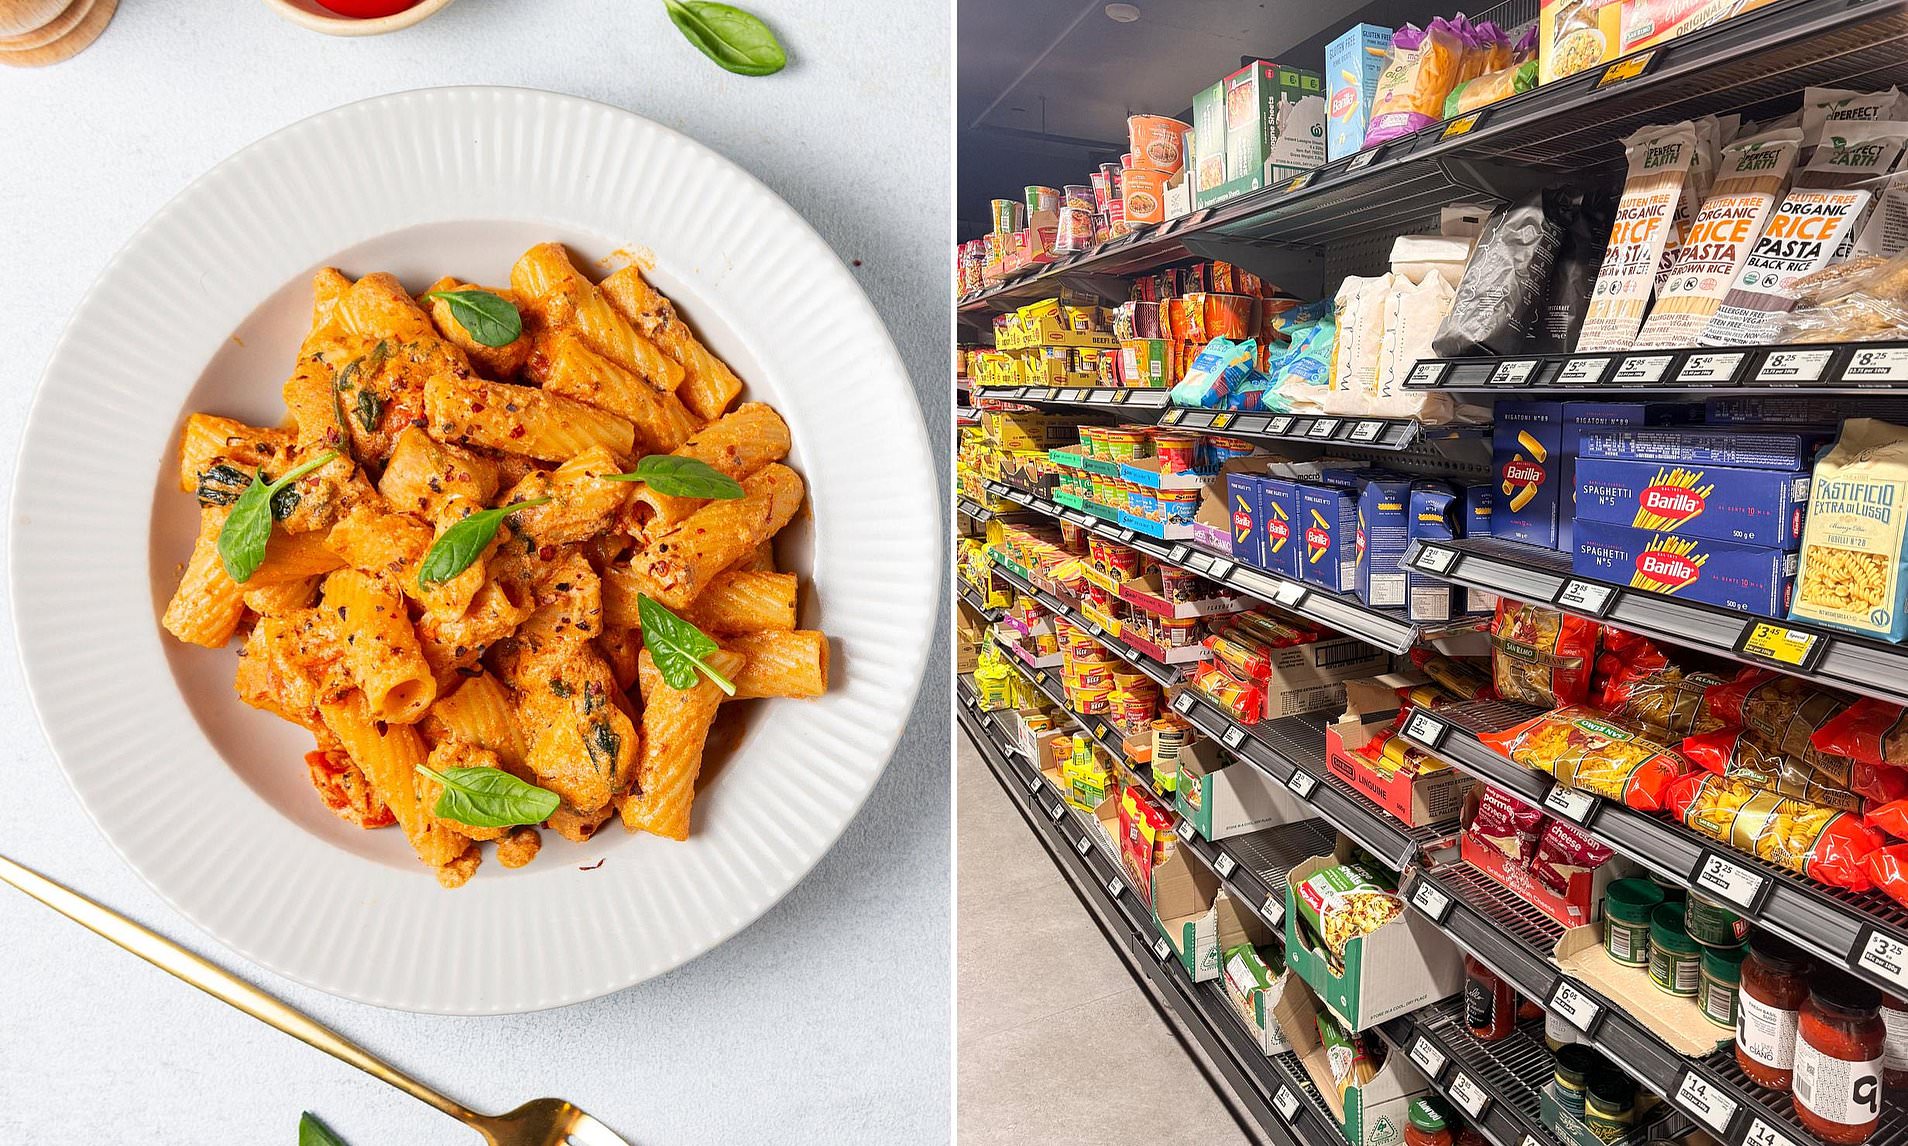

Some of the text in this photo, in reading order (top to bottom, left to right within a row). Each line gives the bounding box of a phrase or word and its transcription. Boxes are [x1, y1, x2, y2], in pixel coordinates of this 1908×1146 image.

[1833, 106, 1879, 120] PERFECT
[1745, 149, 1782, 161] PERFECT
[1736, 158, 1777, 172] EARTH
[1649, 194, 1670, 204] FREE
[1702, 197, 1763, 210] GLUTEN FREE
[1786, 193, 1858, 204] GLUTEN FREE
[1697, 207, 1758, 222] ORGANIC
[1780, 202, 1851, 216] ORGANIC
[1686, 219, 1752, 246] RICE
[1766, 214, 1843, 241] RICE
[1677, 244, 1736, 263] PASTA
[1753, 237, 1823, 259] PASTA
[1671, 264, 1733, 276] BROWN RICE
[1747, 257, 1813, 272] BLACK RICE
[1507, 466, 1541, 481] Barilla
[1583, 485, 1632, 498] SPAGHETTI
[1816, 478, 1895, 507] PASTIFICIO
[1646, 491, 1696, 512] Barilla
[1814, 500, 1845, 516] EXTRA
[1855, 502, 1891, 525] LUSSO
[1235, 514, 1251, 526] Barilla
[1269, 522, 1287, 536] Barilla
[1733, 530, 1742, 538] 500
[1308, 531, 1327, 545] Barilla
[1581, 545, 1628, 561] SPAGHETTI
[1642, 556, 1691, 580] Barilla
[1726, 600, 1736, 608] 500
[1506, 642, 1516, 652] SAN
[1606, 728, 1624, 740] SAN
[1358, 773, 1387, 800] LINGUINE
[1552, 825, 1582, 852] cheese
[1534, 895, 1556, 914] Cheese
[1885, 961, 1898, 973] 100g
[1414, 994, 1428, 1003] PLACE
[1749, 1001, 1763, 1012] FRESH
[1763, 1014, 1777, 1022] SUGO
[1749, 1046, 1774, 1062] CIANO
